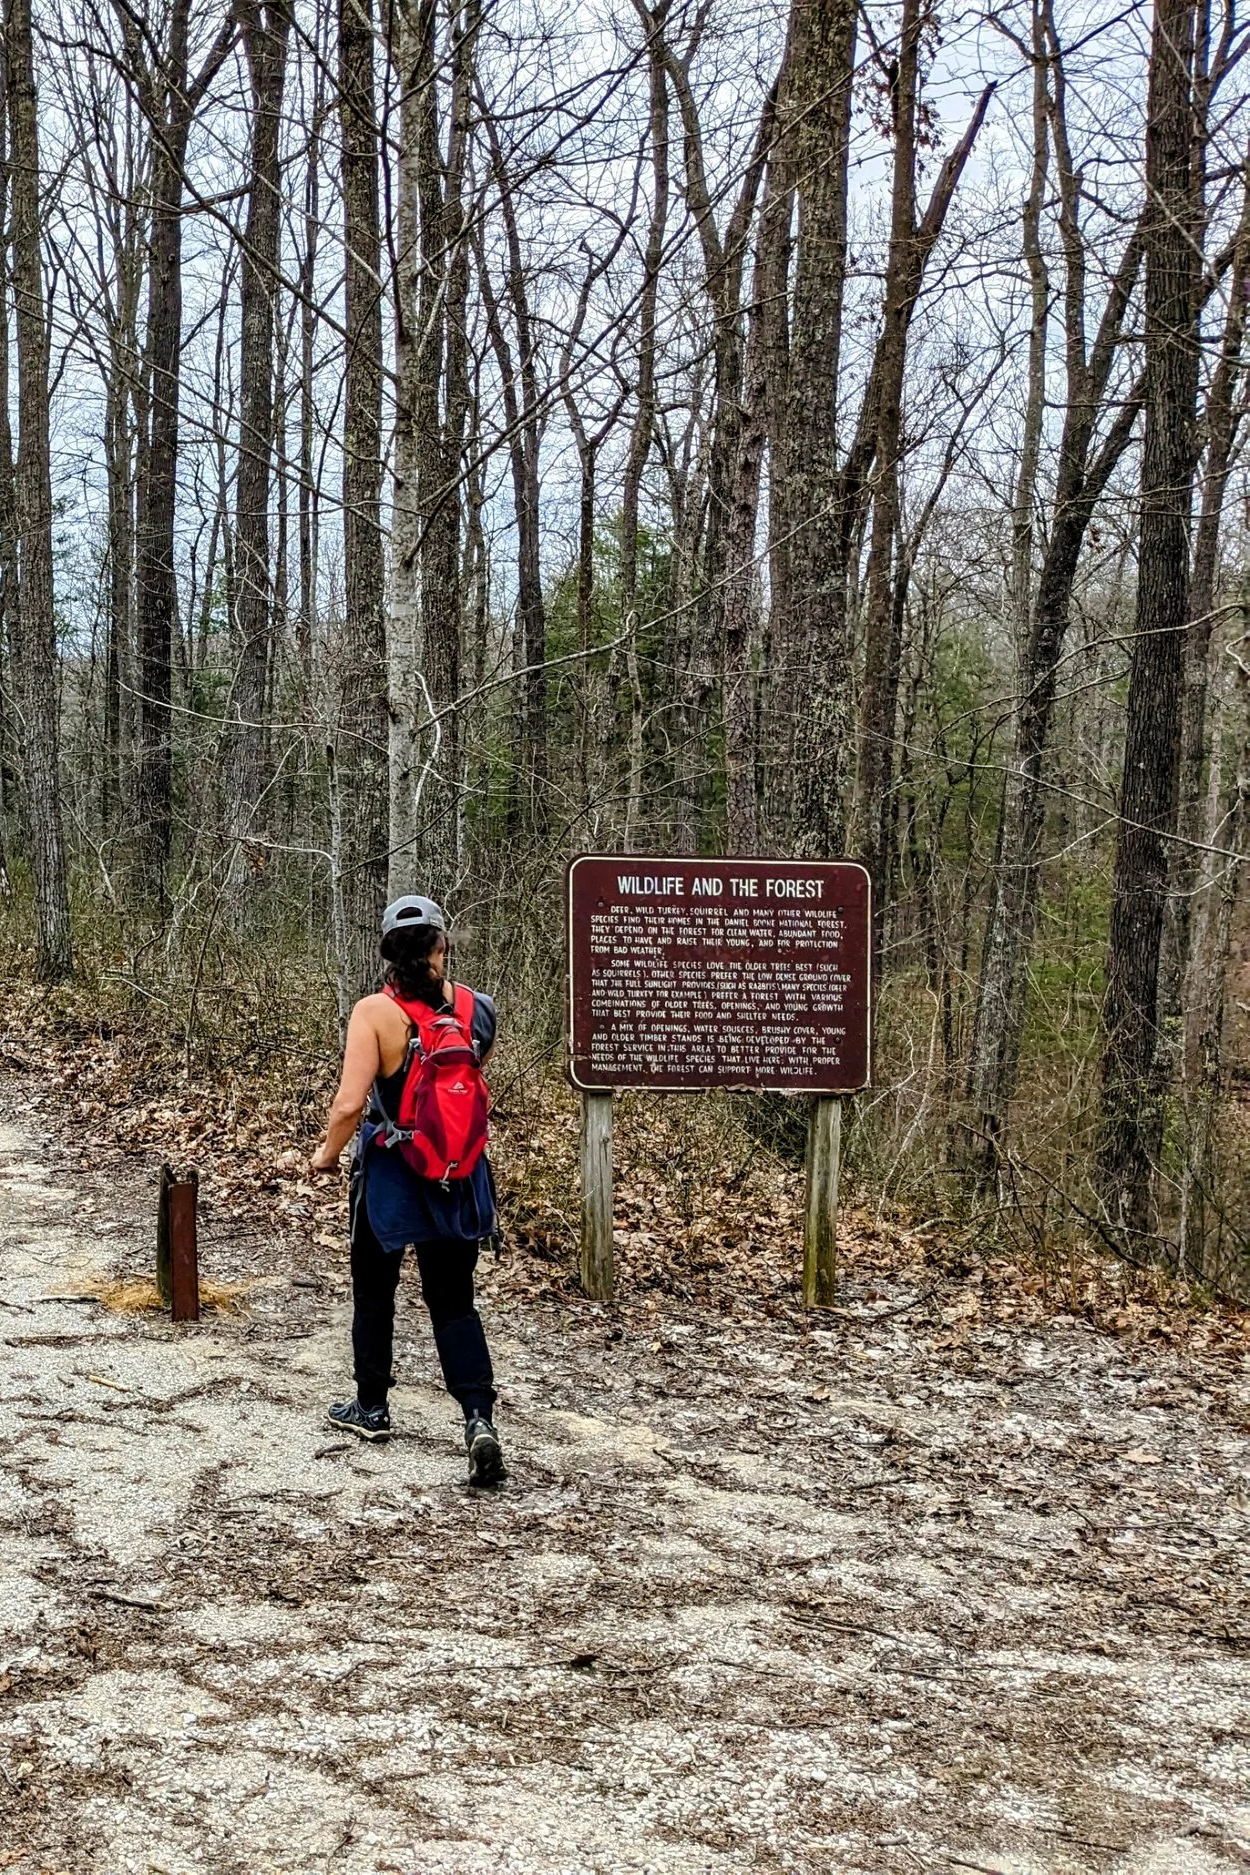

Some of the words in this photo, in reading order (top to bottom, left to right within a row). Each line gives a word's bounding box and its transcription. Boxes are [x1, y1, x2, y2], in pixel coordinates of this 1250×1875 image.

[617, 875, 684, 896] WILDLIFE
[692, 877, 723, 896] AND
[730, 878, 758, 897] THE
[766, 878, 824, 898] FOREST
[635, 906, 654, 915] WILD
[690, 907, 728, 916] SQUIRREL
[733, 908, 749, 917] AND
[753, 908, 774, 917] MANY
[778, 909, 800, 918] OTHER
[804, 909, 836, 918] WILDLIFE
[590, 915, 618, 924] SPECIES
[623, 916, 640, 924] FIND
[644, 916, 665, 925] THEIR
[668, 916, 690, 926] HOMES
[695, 917, 703, 926] IN
[707, 917, 719, 926] THE
[724, 918, 748, 927] DANIEL
[779, 919, 812, 928] NATIONAL
[591, 925, 610, 934] THEY
[614, 925, 643, 935] DEPEND
[647, 926, 658, 935] ON
[661, 926, 674, 936] THE
[679, 927, 706, 936] FOREST
[711, 927, 724, 936] FOR
[726, 928, 747, 937] CLEAN
[779, 929, 816, 938] ABUNDANT
[590, 935, 617, 944] PLACES
[622, 936, 632, 944] TO
[634, 936, 652, 945] HAVE
[657, 936, 672, 945] AND
[676, 937, 697, 946] RAISE
[702, 937, 722, 946] THEIR
[758, 938, 774, 947] AND
[777, 939, 790, 948] FOR
[795, 939, 838, 949] PROTECTION
[590, 945, 610, 954] FROM
[614, 946, 628, 955] BAD
[611, 959, 630, 968] SOME
[634, 960, 667, 969] WILDLIFE
[673, 960, 701, 970] SPECIES
[706, 961, 724, 970] LOVE
[729, 962, 742, 970] THE
[745, 962, 766, 971] OLDER
[770, 962, 790, 971] TREES
[795, 963, 812, 972] BEST
[592, 968, 600, 978] AS
[651, 970, 674, 979] OTHER
[678, 970, 706, 980] SPECIES
[711, 971, 737, 980] PREFER
[742, 972, 754, 981] THE
[758, 972, 772, 981] LOW
[775, 972, 796, 982] DENSE
[799, 973, 828, 982] GROUND
[830, 973, 851, 983] COVER
[591, 978, 608, 988] THAT
[611, 979, 622, 988] THE
[625, 979, 641, 988] FULL
[644, 980, 676, 989] SUNLIGHT
[738, 982, 746, 990] AS
[781, 982, 800, 991] MANY
[802, 983, 826, 992] SPECIES
[592, 988, 605, 997] AND
[607, 989, 624, 998] WILD
[627, 989, 653, 998] TURKEY
[656, 990, 668, 999] FOR
[711, 991, 738, 1000] PREFER
[742, 992, 747, 1000] A
[750, 992, 778, 1001] FOREST
[784, 992, 805, 1001] WITH
[811, 993, 842, 1002] VARIOUS
[591, 998, 646, 1008] COMBINATIONS
[651, 1000, 660, 1008] OF
[664, 1000, 688, 1009] OLDER
[765, 1002, 780, 1011] AND
[784, 1002, 808, 1011] YOUNG
[812, 1003, 843, 1012] GROWTH
[592, 1009, 609, 1017] THAT
[614, 1009, 630, 1018] BEST
[636, 1010, 666, 1018] PROVIDE
[670, 1010, 690, 1019] THEIR
[694, 1011, 713, 1019] FOOD
[716, 1011, 731, 1020] AND
[736, 1012, 766, 1020] SHELTER
[611, 1023, 616, 1031] A
[619, 1023, 633, 1032] MIX
[638, 1023, 646, 1032] OF
[694, 1024, 718, 1033] WATER
[762, 1026, 791, 1035] BRUSHY
[822, 1027, 846, 1036] YOUNG
[592, 1032, 608, 1041] AND
[611, 1032, 634, 1042] OLDER
[640, 1033, 667, 1042] TIMBER
[672, 1034, 701, 1043] STANDS
[707, 1034, 714, 1043] IS
[718, 1035, 741, 1044] BEING
[746, 1035, 789, 1045] DEVELOPED
[795, 1036, 806, 1045] BY
[811, 1036, 825, 1045] THE
[591, 1042, 618, 1051] FOREST
[623, 1043, 653, 1052] SERVICE
[658, 1043, 666, 1052] IN
[670, 1044, 686, 1053] THIS
[692, 1044, 711, 1053] AREA
[716, 1044, 726, 1053] TO
[731, 1045, 759, 1054] BETTER
[765, 1046, 796, 1055] PROVIDE
[802, 1046, 817, 1055] FOR
[822, 1047, 836, 1056] THE
[591, 1052, 614, 1061] NEEDS
[617, 1053, 626, 1062] OF
[629, 1053, 642, 1062] THE
[646, 1053, 678, 1063] WILDLIFE
[686, 1054, 715, 1063] SPECIES
[722, 1055, 740, 1064] THAT
[744, 1055, 759, 1064] LIVE
[788, 1056, 808, 1065] WITH
[812, 1057, 840, 1066] PROPER
[650, 1064, 662, 1072] THE
[667, 1064, 694, 1073] FOREST
[698, 1065, 713, 1074] CAN
[718, 1065, 750, 1074] SUPPORT
[755, 1066, 774, 1075] MORE
[780, 1066, 816, 1076] WILDLIFE.
